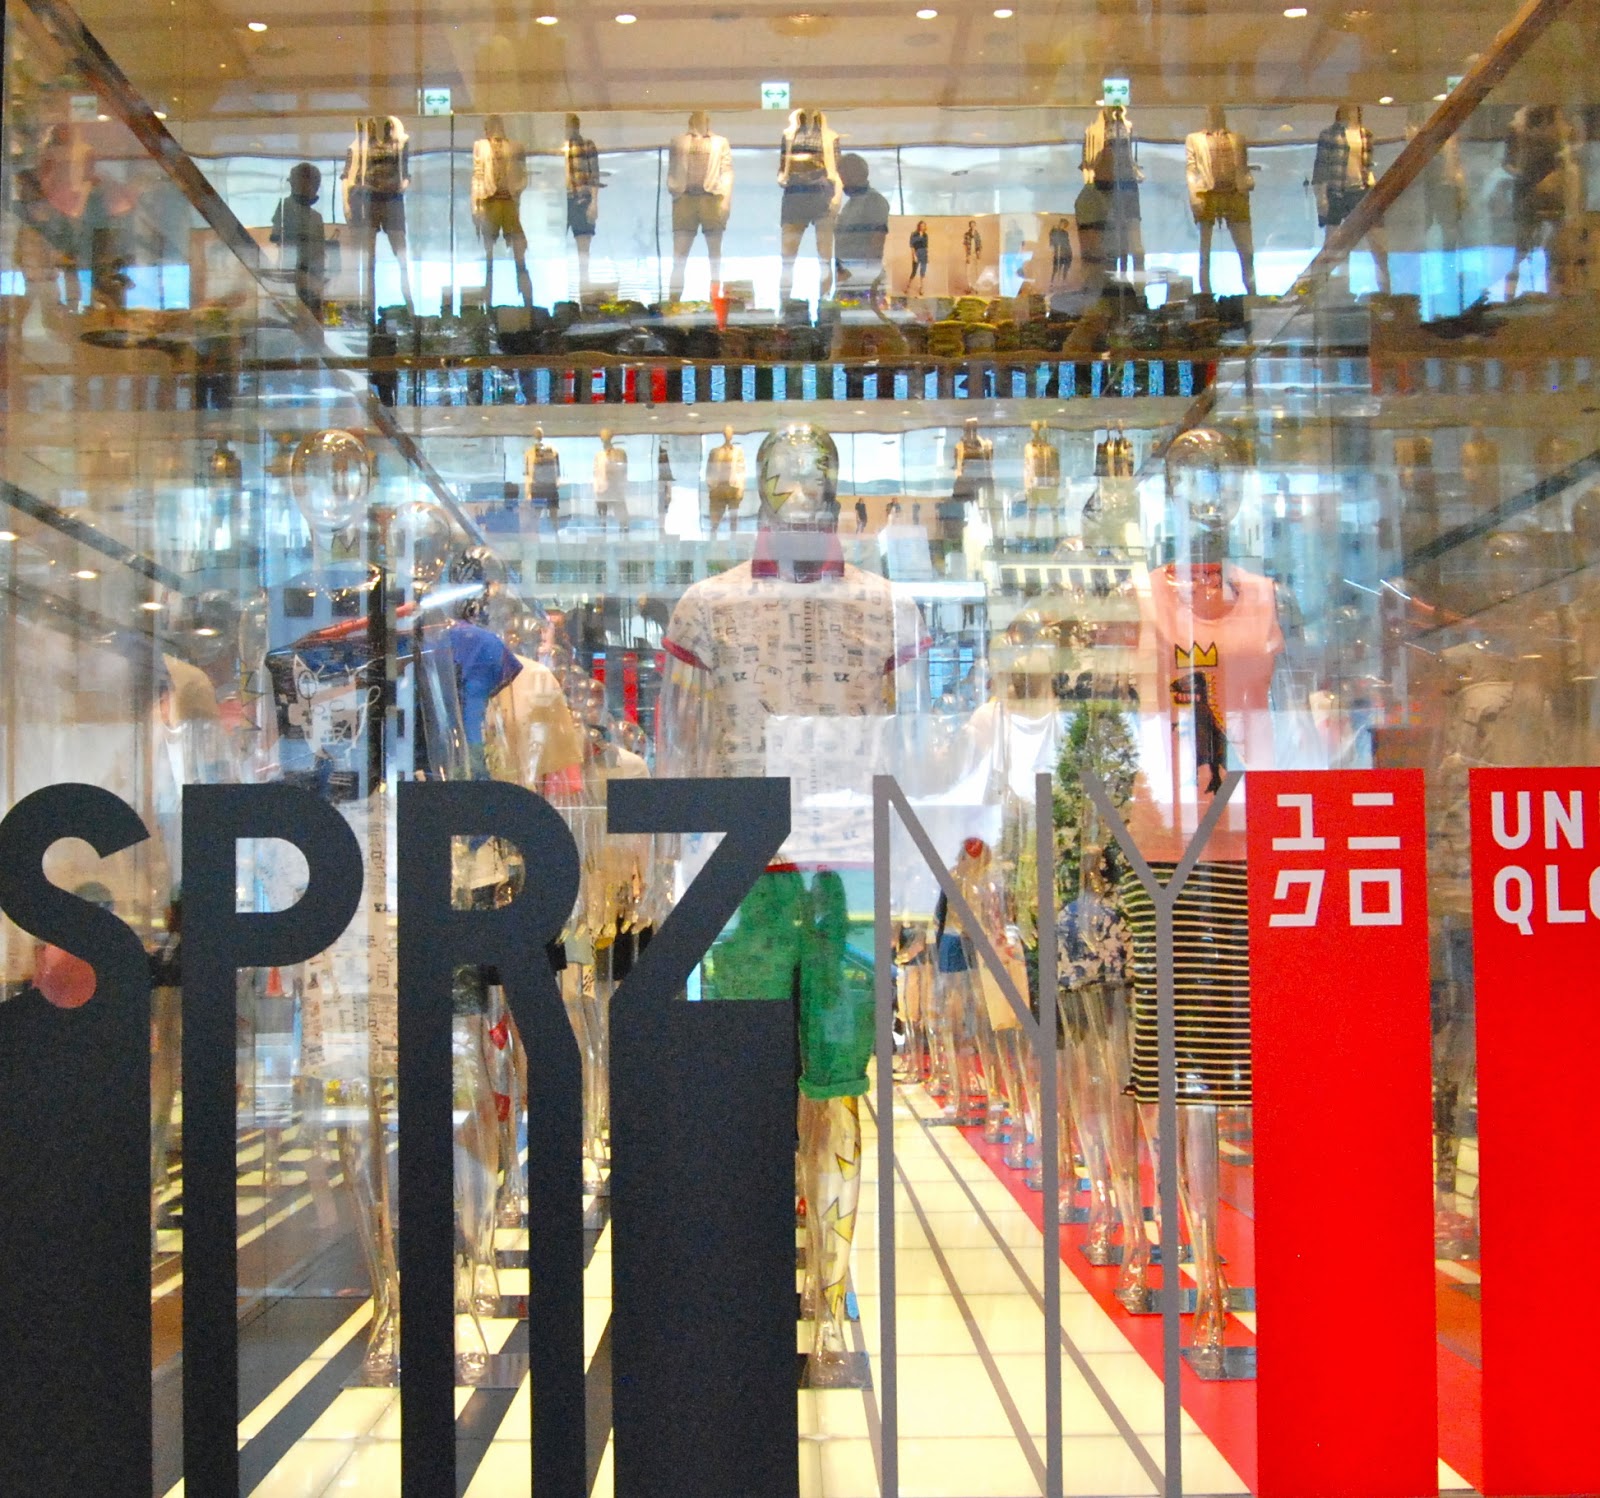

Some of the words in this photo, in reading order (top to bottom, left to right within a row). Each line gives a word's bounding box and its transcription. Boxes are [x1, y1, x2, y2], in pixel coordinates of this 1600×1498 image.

[1271, 792, 1401, 851] ユニ
[1491, 790, 1600, 851] UN
[1268, 868, 1403, 928] クロ
